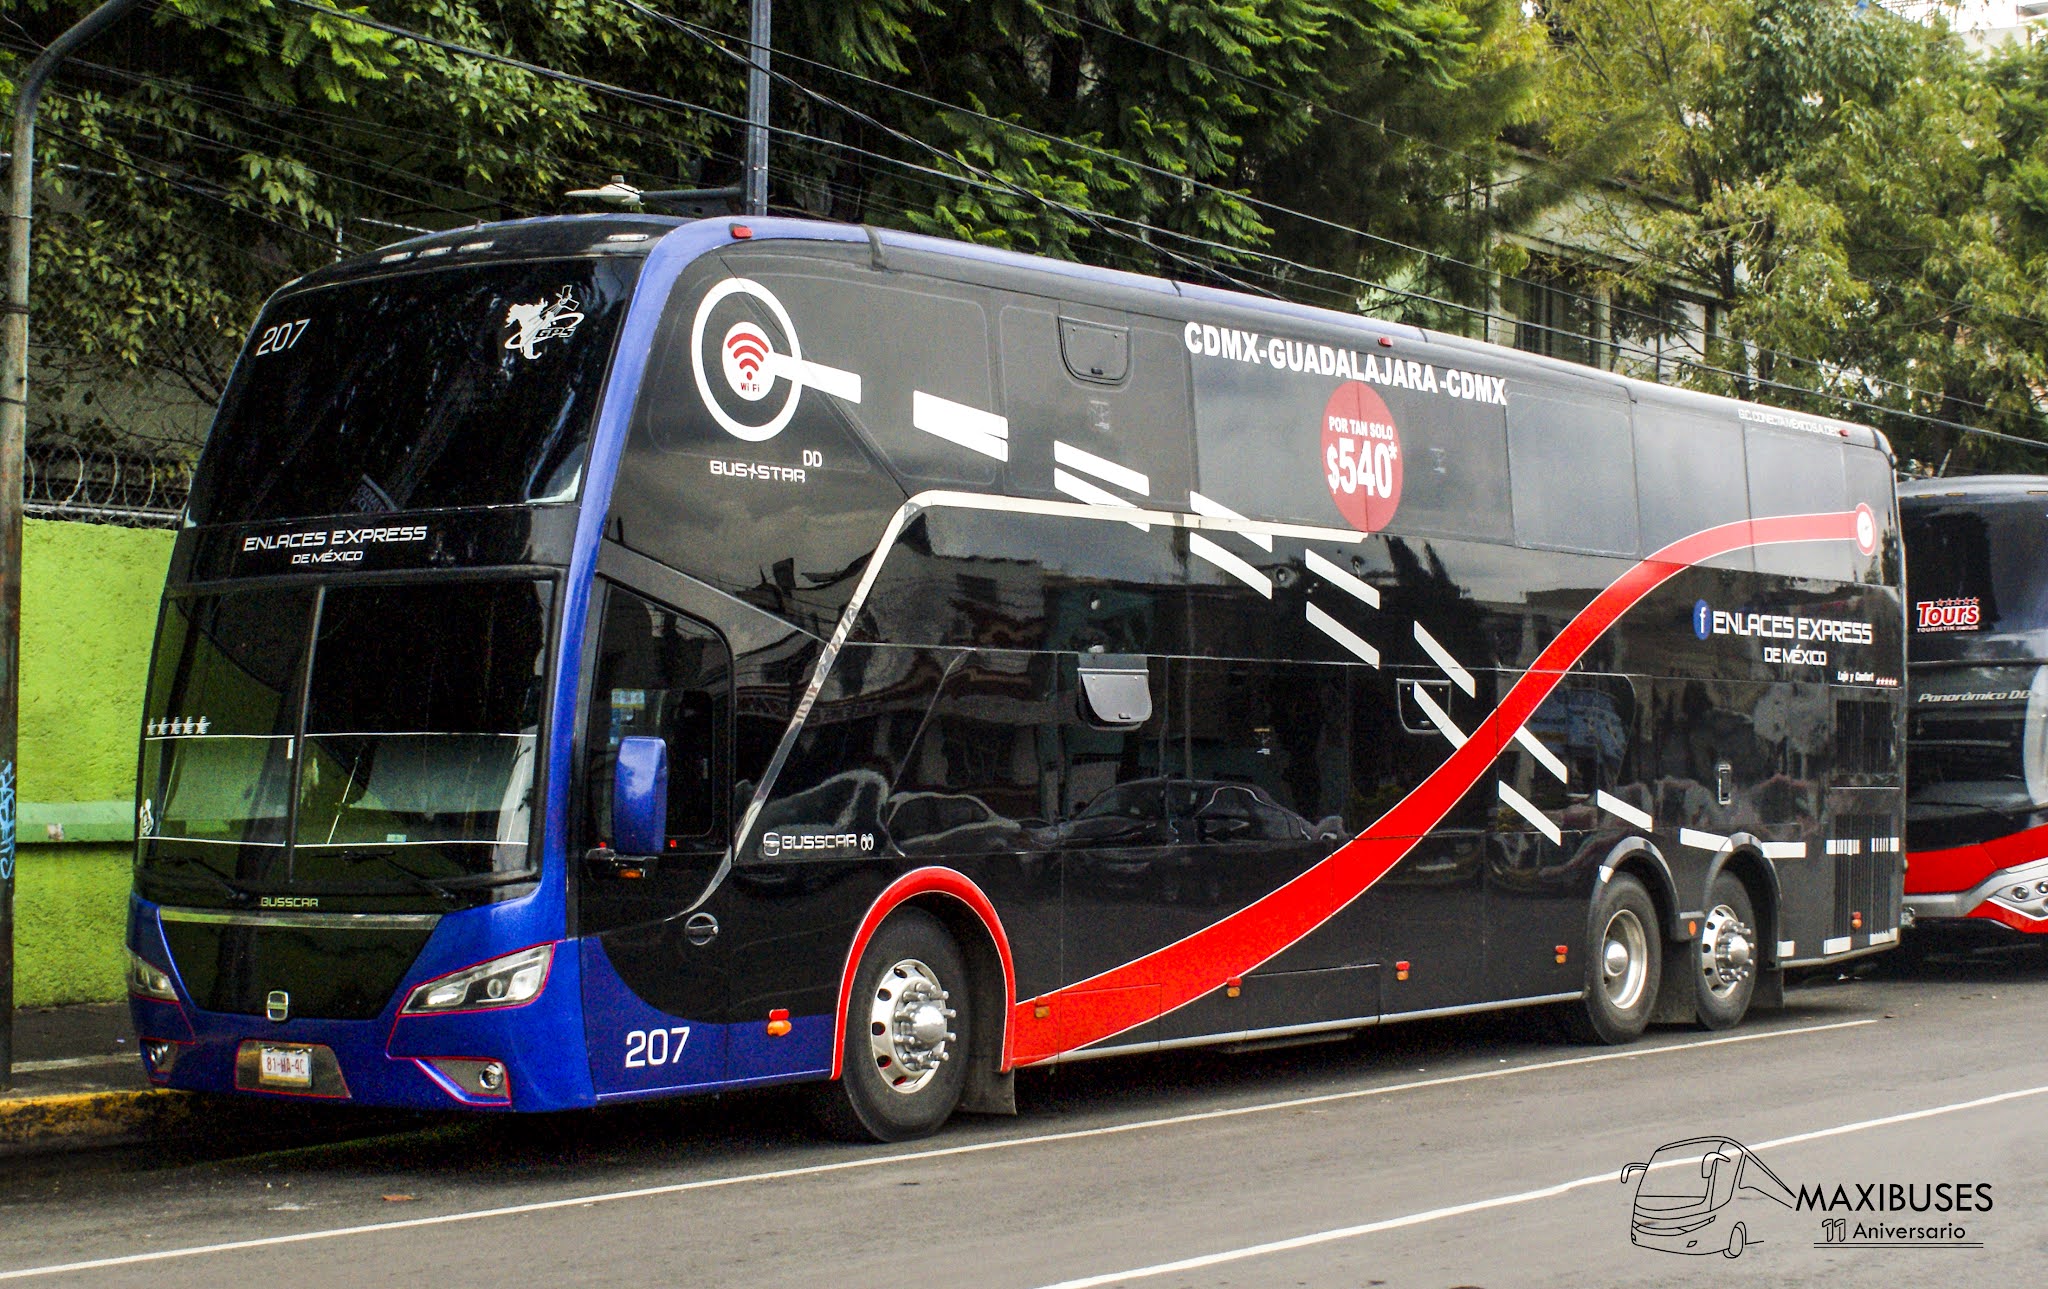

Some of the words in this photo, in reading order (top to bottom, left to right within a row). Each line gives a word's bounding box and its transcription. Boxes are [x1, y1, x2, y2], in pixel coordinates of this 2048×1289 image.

[256, 318, 310, 356] 207
[535, 326, 577, 338] GPS
[1328, 416, 1349, 433] POR
[1349, 419, 1368, 436] TAN
[1369, 422, 1394, 440] SOLO
[802, 450, 822, 467] DD
[243, 532, 327, 551] ENLACES
[331, 526, 427, 545] EXPRESS
[291, 554, 310, 564] DE
[311, 549, 364, 563] MÉXICO
[1916, 601, 1980, 627] Tours
[1713, 610, 1795, 639] ENLACES
[1797, 617, 1873, 645] EXPRESS
[1764, 647, 1782, 663] DE
[1782, 644, 1828, 666] MÉXICO
[1918, 690, 2007, 703] Panorámico
[781, 833, 858, 850] BUSSCAR
[260, 896, 319, 908] BUSSCAR
[625, 1026, 691, 1068] 207
